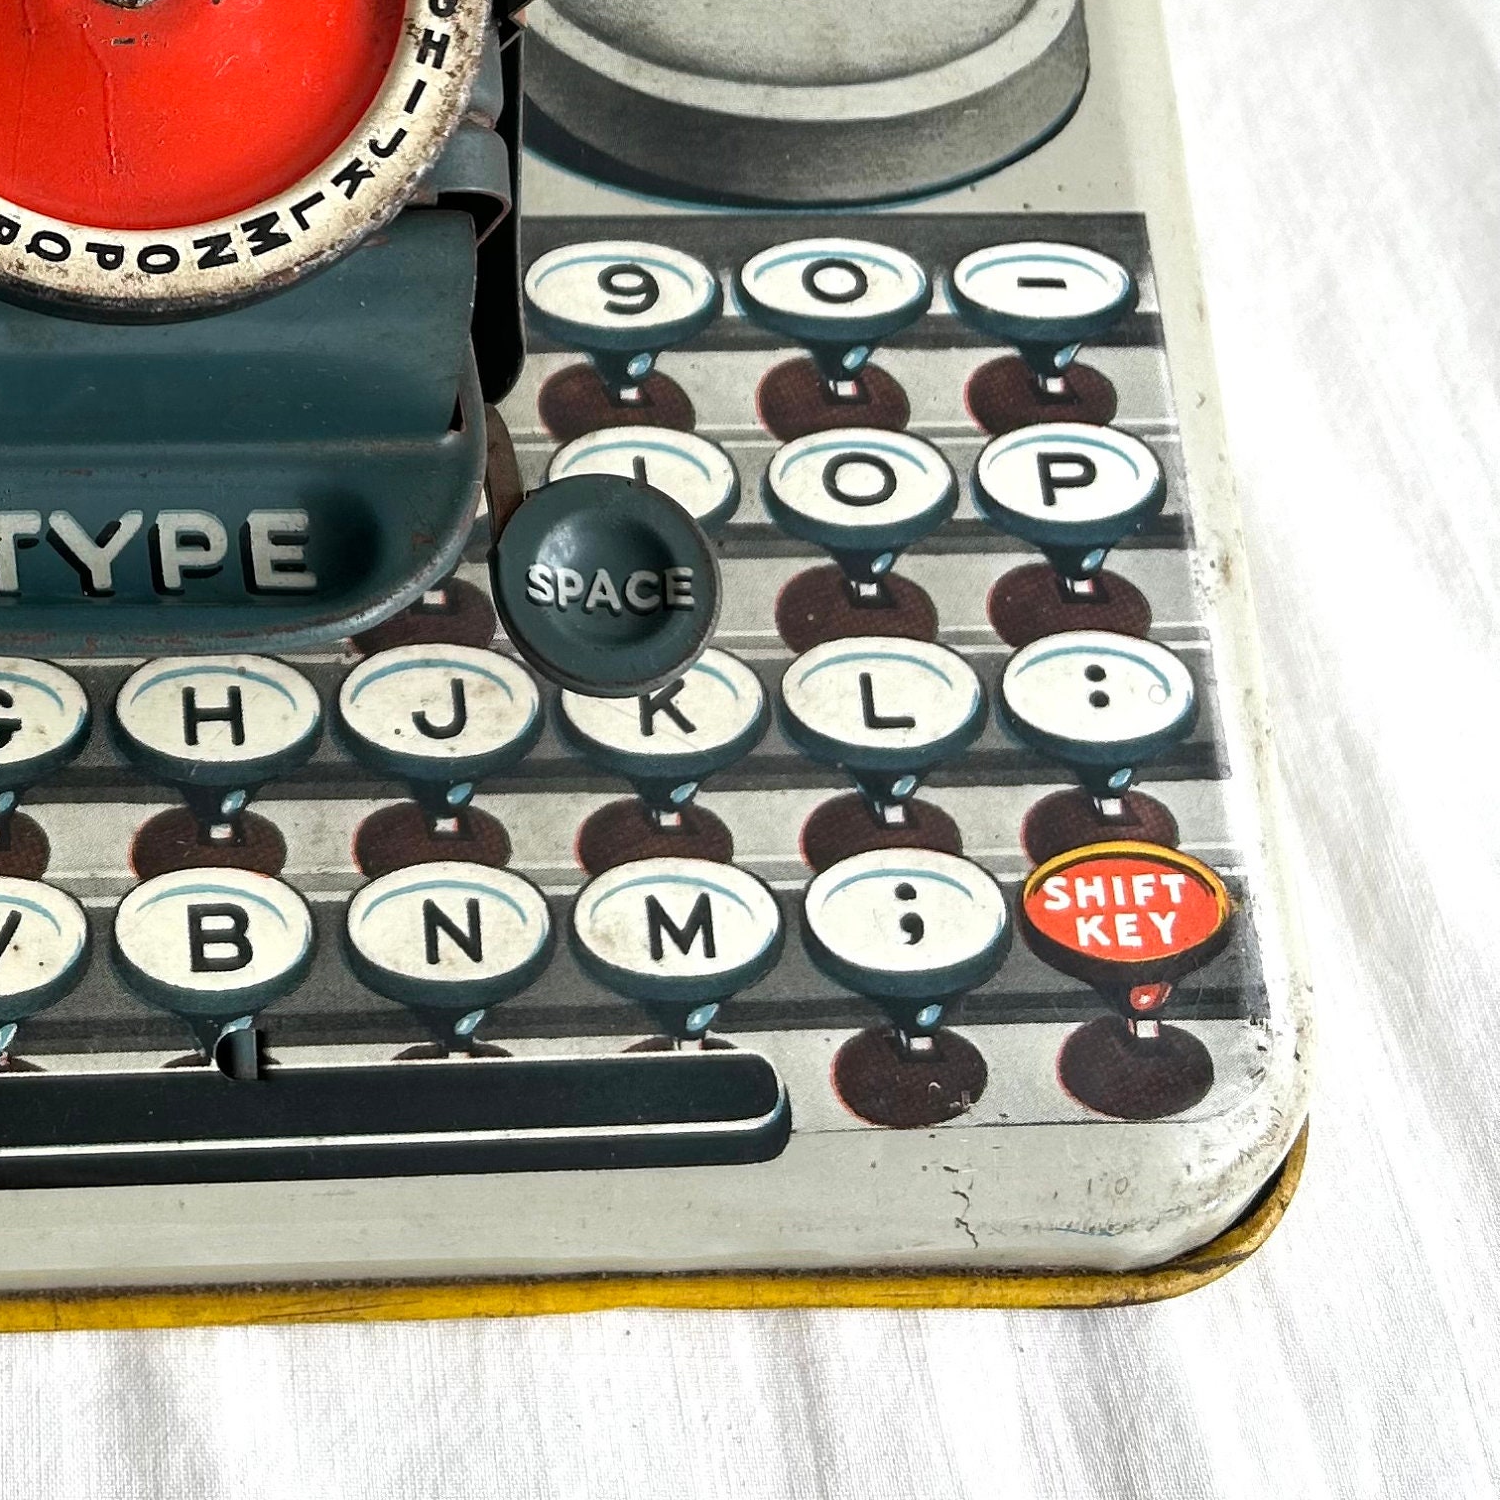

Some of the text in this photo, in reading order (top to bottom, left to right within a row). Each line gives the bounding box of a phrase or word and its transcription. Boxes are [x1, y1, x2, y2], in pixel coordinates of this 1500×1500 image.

[416, 28, 450, 69] H
[368, 128, 407, 158] J
[331, 157, 375, 200] K
[241, 211, 292, 257] M
[289, 192, 325, 231] L
[25, 230, 71, 262] Q
[85, 242, 124, 270] P
[137, 244, 180, 274] O
[193, 233, 238, 269] N
[598, 263, 659, 315] 9
[822, 452, 897, 507] O
[1037, 453, 1097, 506] P
[527, 563, 694, 610] SPACE
[182, 686, 245, 746] H
[412, 678, 467, 739] J
[639, 678, 700, 737] K
[859, 673, 916, 730] L
[1043, 873, 1186, 911] SHIFT
[188, 903, 253, 973] B
[423, 898, 483, 965] N
[645, 893, 716, 961] M
[1076, 911, 1176, 947] KEY
